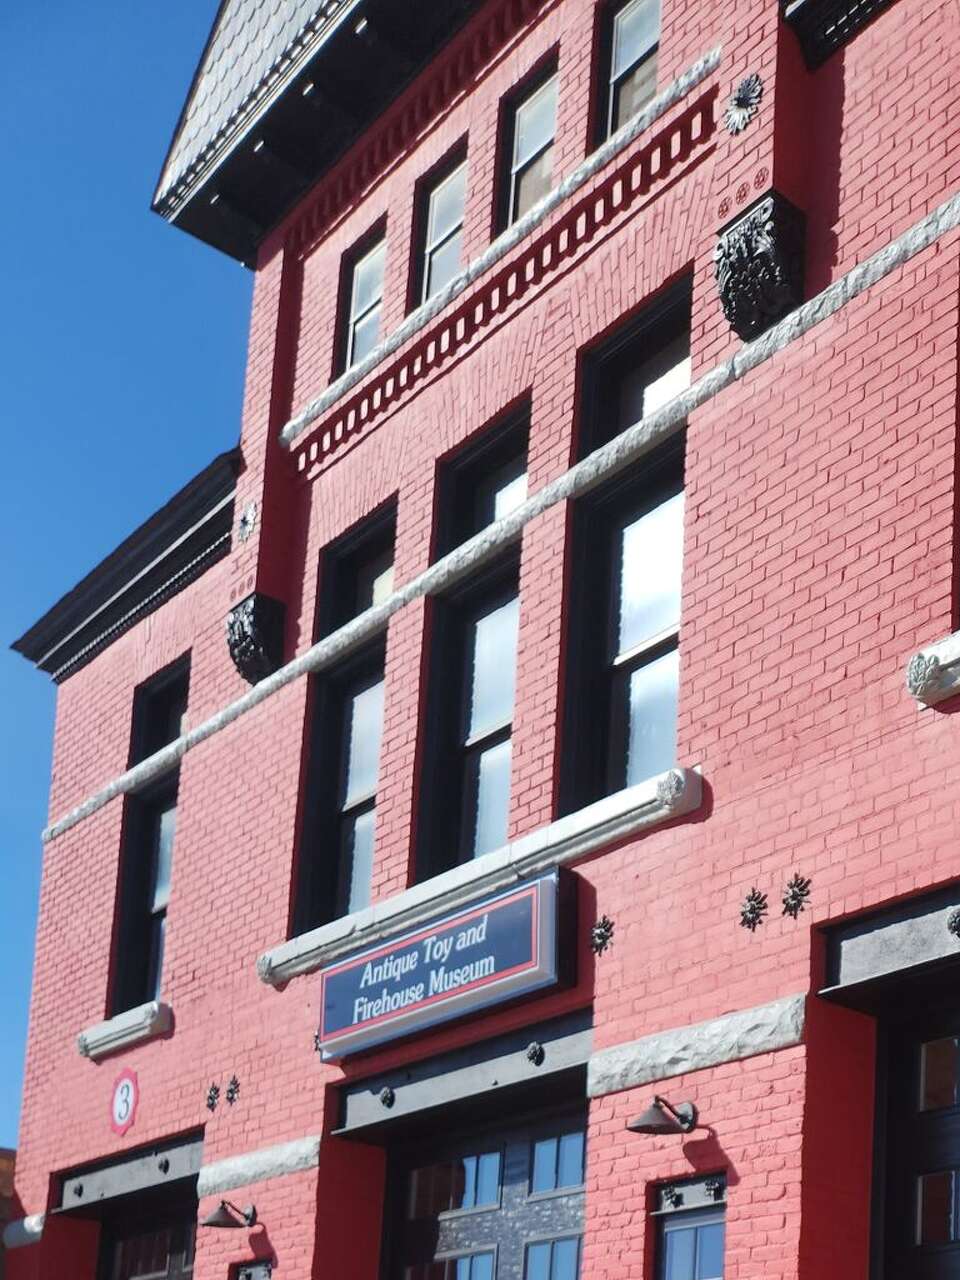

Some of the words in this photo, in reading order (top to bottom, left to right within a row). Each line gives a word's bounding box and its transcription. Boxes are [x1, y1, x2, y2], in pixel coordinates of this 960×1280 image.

[360, 950, 418, 988] Antique
[423, 935, 453, 963] Toy
[455, 914, 488, 950] and
[352, 982, 425, 1024] Firehouse
[428, 955, 495, 996] Museum
[118, 1083, 130, 1120] 3
